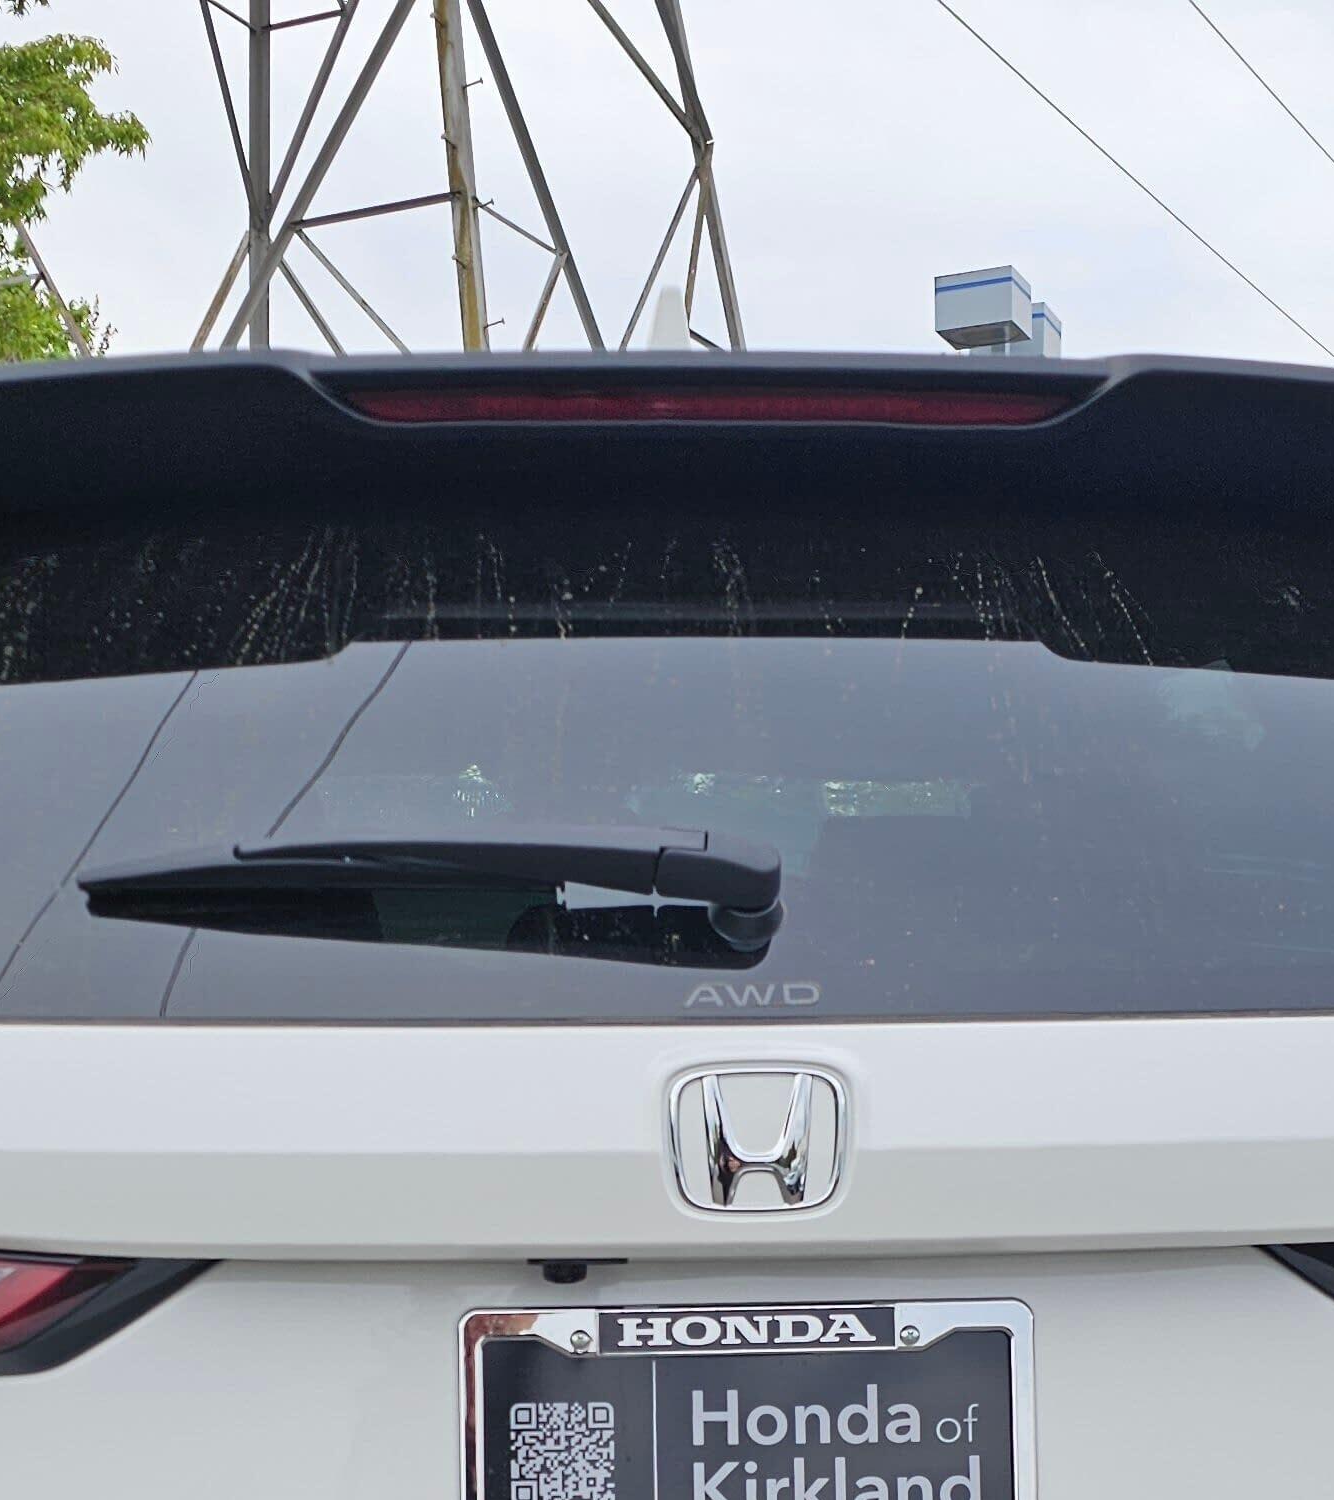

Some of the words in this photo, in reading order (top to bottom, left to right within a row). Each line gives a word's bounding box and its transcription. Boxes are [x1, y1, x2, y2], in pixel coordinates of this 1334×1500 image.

[683, 983, 820, 1008] AWD
[617, 1313, 877, 1347] HONDA
[692, 1383, 921, 1446] Honda
[935, 1403, 979, 1443] of
